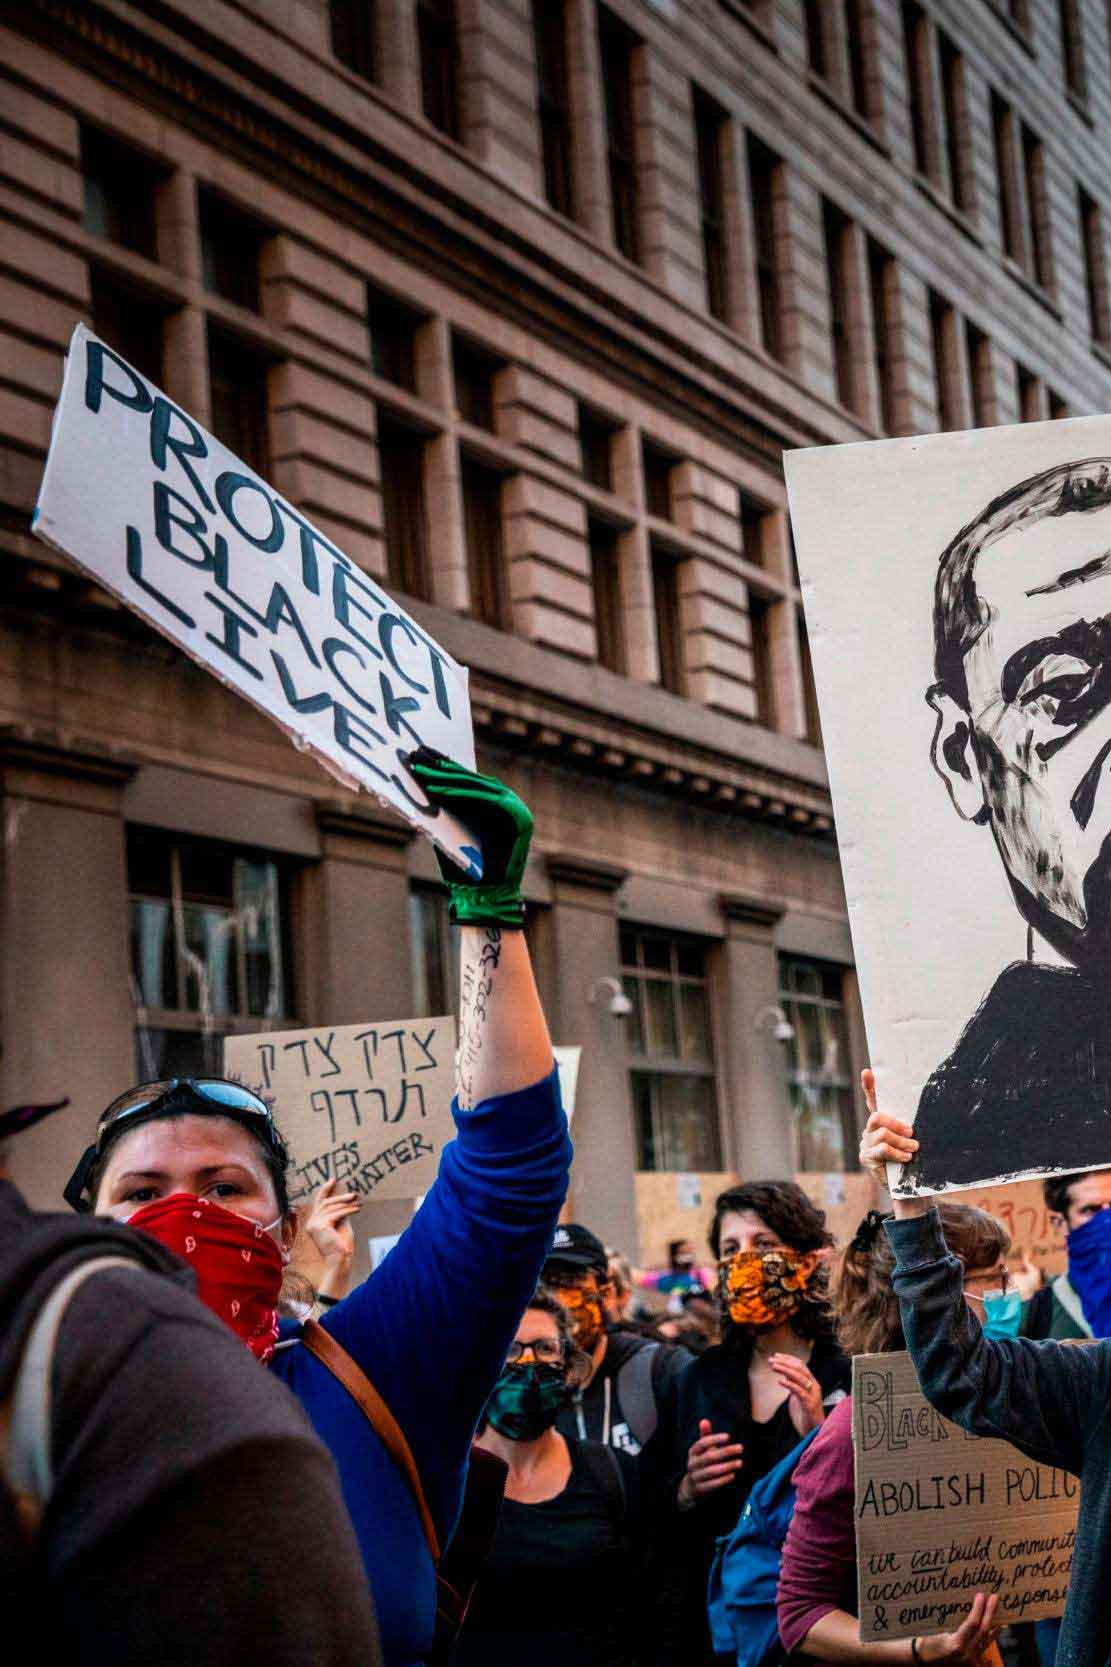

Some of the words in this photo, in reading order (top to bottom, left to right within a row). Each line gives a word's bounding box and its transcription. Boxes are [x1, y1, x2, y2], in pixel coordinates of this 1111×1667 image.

[85, 340, 457, 720] PROTECT
[154, 481, 423, 748] BLACK
[257, 1032, 342, 1088] צדק
[354, 1028, 438, 1080] צדק
[310, 1079, 426, 1143] תרדף
[858, 1472, 984, 1519] ABOLISH
[1006, 1467, 1076, 1505] POLIC
[867, 1551, 900, 1575] we
[948, 1536, 993, 1564] build
[999, 1531, 1077, 1560] communit
[872, 1606, 888, 1632] &
[900, 1600, 973, 1625] emergenc
